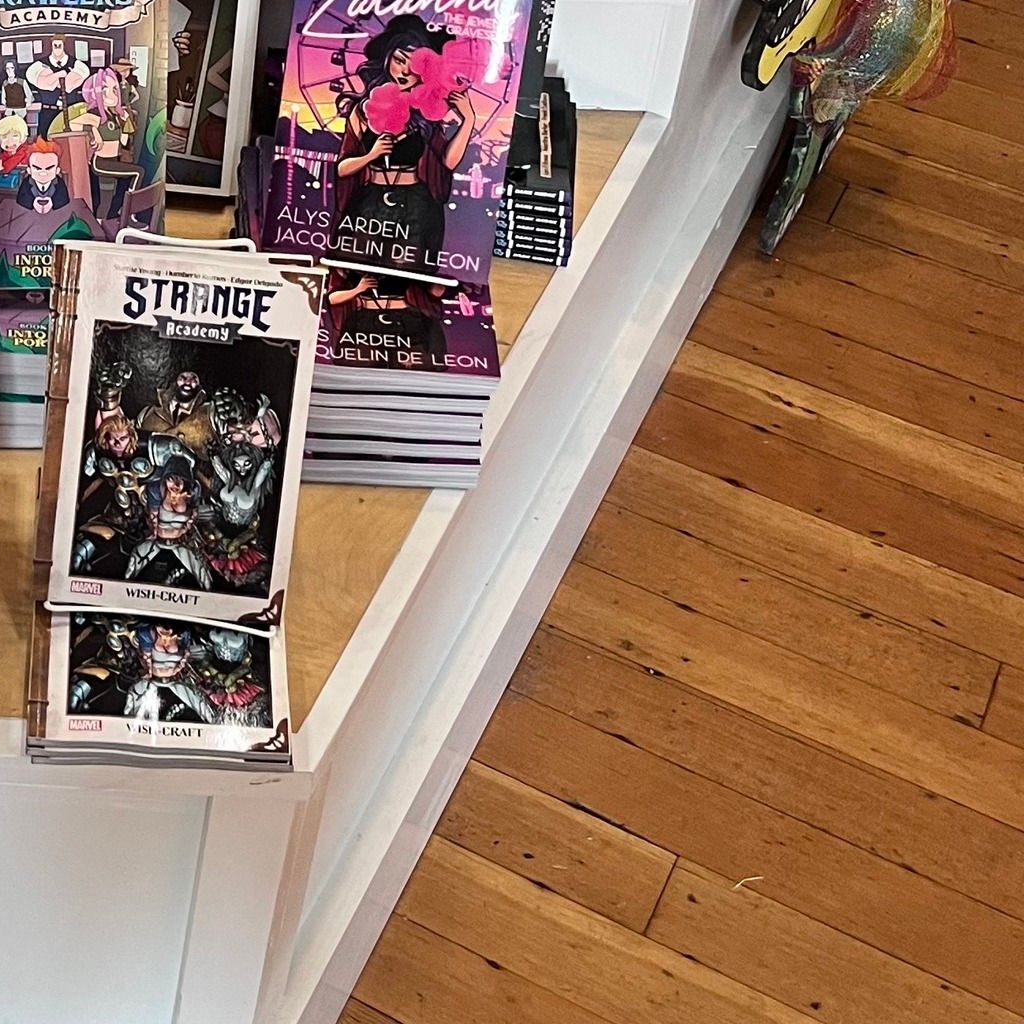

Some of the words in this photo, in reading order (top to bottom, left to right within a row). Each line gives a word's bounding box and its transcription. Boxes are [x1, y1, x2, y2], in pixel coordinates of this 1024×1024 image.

[10, 10, 103, 25] ACADEMY
[444, 12, 466, 25] THE
[426, 22, 443, 32] OF
[277, 204, 331, 228] ALYS
[338, 215, 410, 240] ARDEN
[274, 228, 383, 257] JACQUELIN
[391, 245, 417, 262] DE
[424, 251, 480, 273] LEON
[15, 254, 53, 266] INTO
[123, 276, 278, 333] STRANGE
[8, 329, 47, 339] INTO
[166, 322, 229, 342] Academy
[339, 332, 411, 349] ARDEN
[397, 350, 424, 364] DE
[432, 354, 489, 369] LEON
[71, 581, 103, 595] MARVEL
[126, 587, 201, 606] WISH-CRAFT
[69, 719, 102, 731] MARVEL
